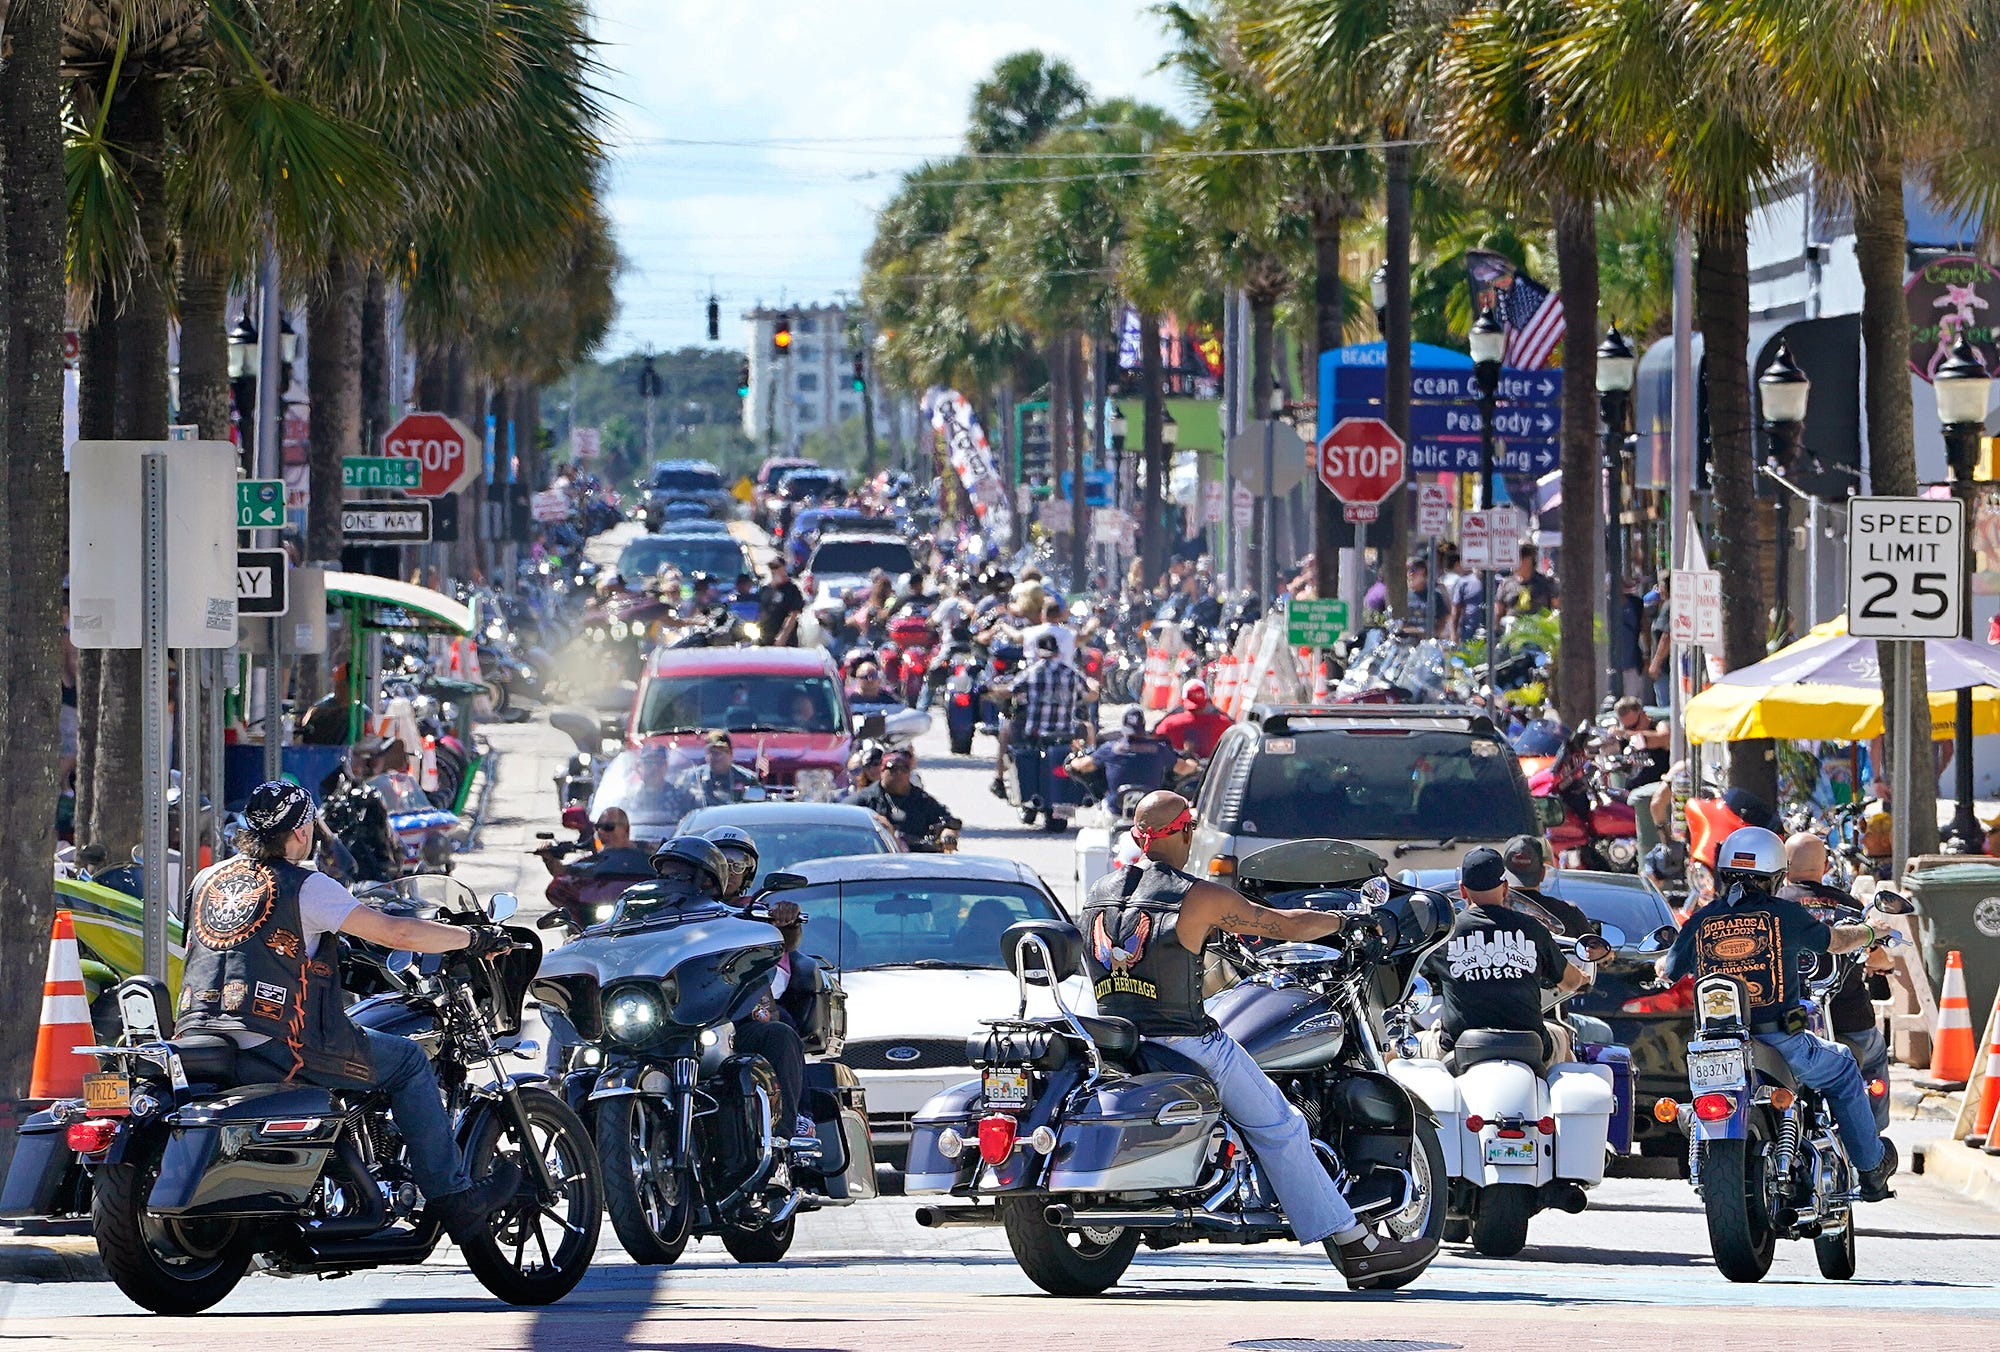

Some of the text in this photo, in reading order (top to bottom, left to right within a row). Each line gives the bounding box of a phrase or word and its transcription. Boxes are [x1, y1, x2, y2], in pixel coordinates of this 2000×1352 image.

[1413, 376, 1533, 397] cean Cnter
[1446, 410, 1532, 437] Peaody
[389, 440, 462, 472] STOP
[1326, 445, 1399, 478] STOP
[1412, 445, 1448, 467] blic
[342, 466, 380, 484] ern
[344, 514, 418, 529] ONE WAY
[1860, 514, 1952, 534] SPEED
[1870, 543, 1940, 562] LIMIT
[237, 571, 262, 594] AY
[1860, 571, 1949, 619] 25
[1703, 917, 1767, 939] BOBAROSA
[1711, 927, 1756, 940] SALOON
[1462, 953, 1531, 967] BAY AREA
[1464, 967, 1523, 982] RIDERS
[1094, 976, 1157, 1000] LATIN HERITAGE
[1696, 1062, 1733, 1078] 883ZN7
